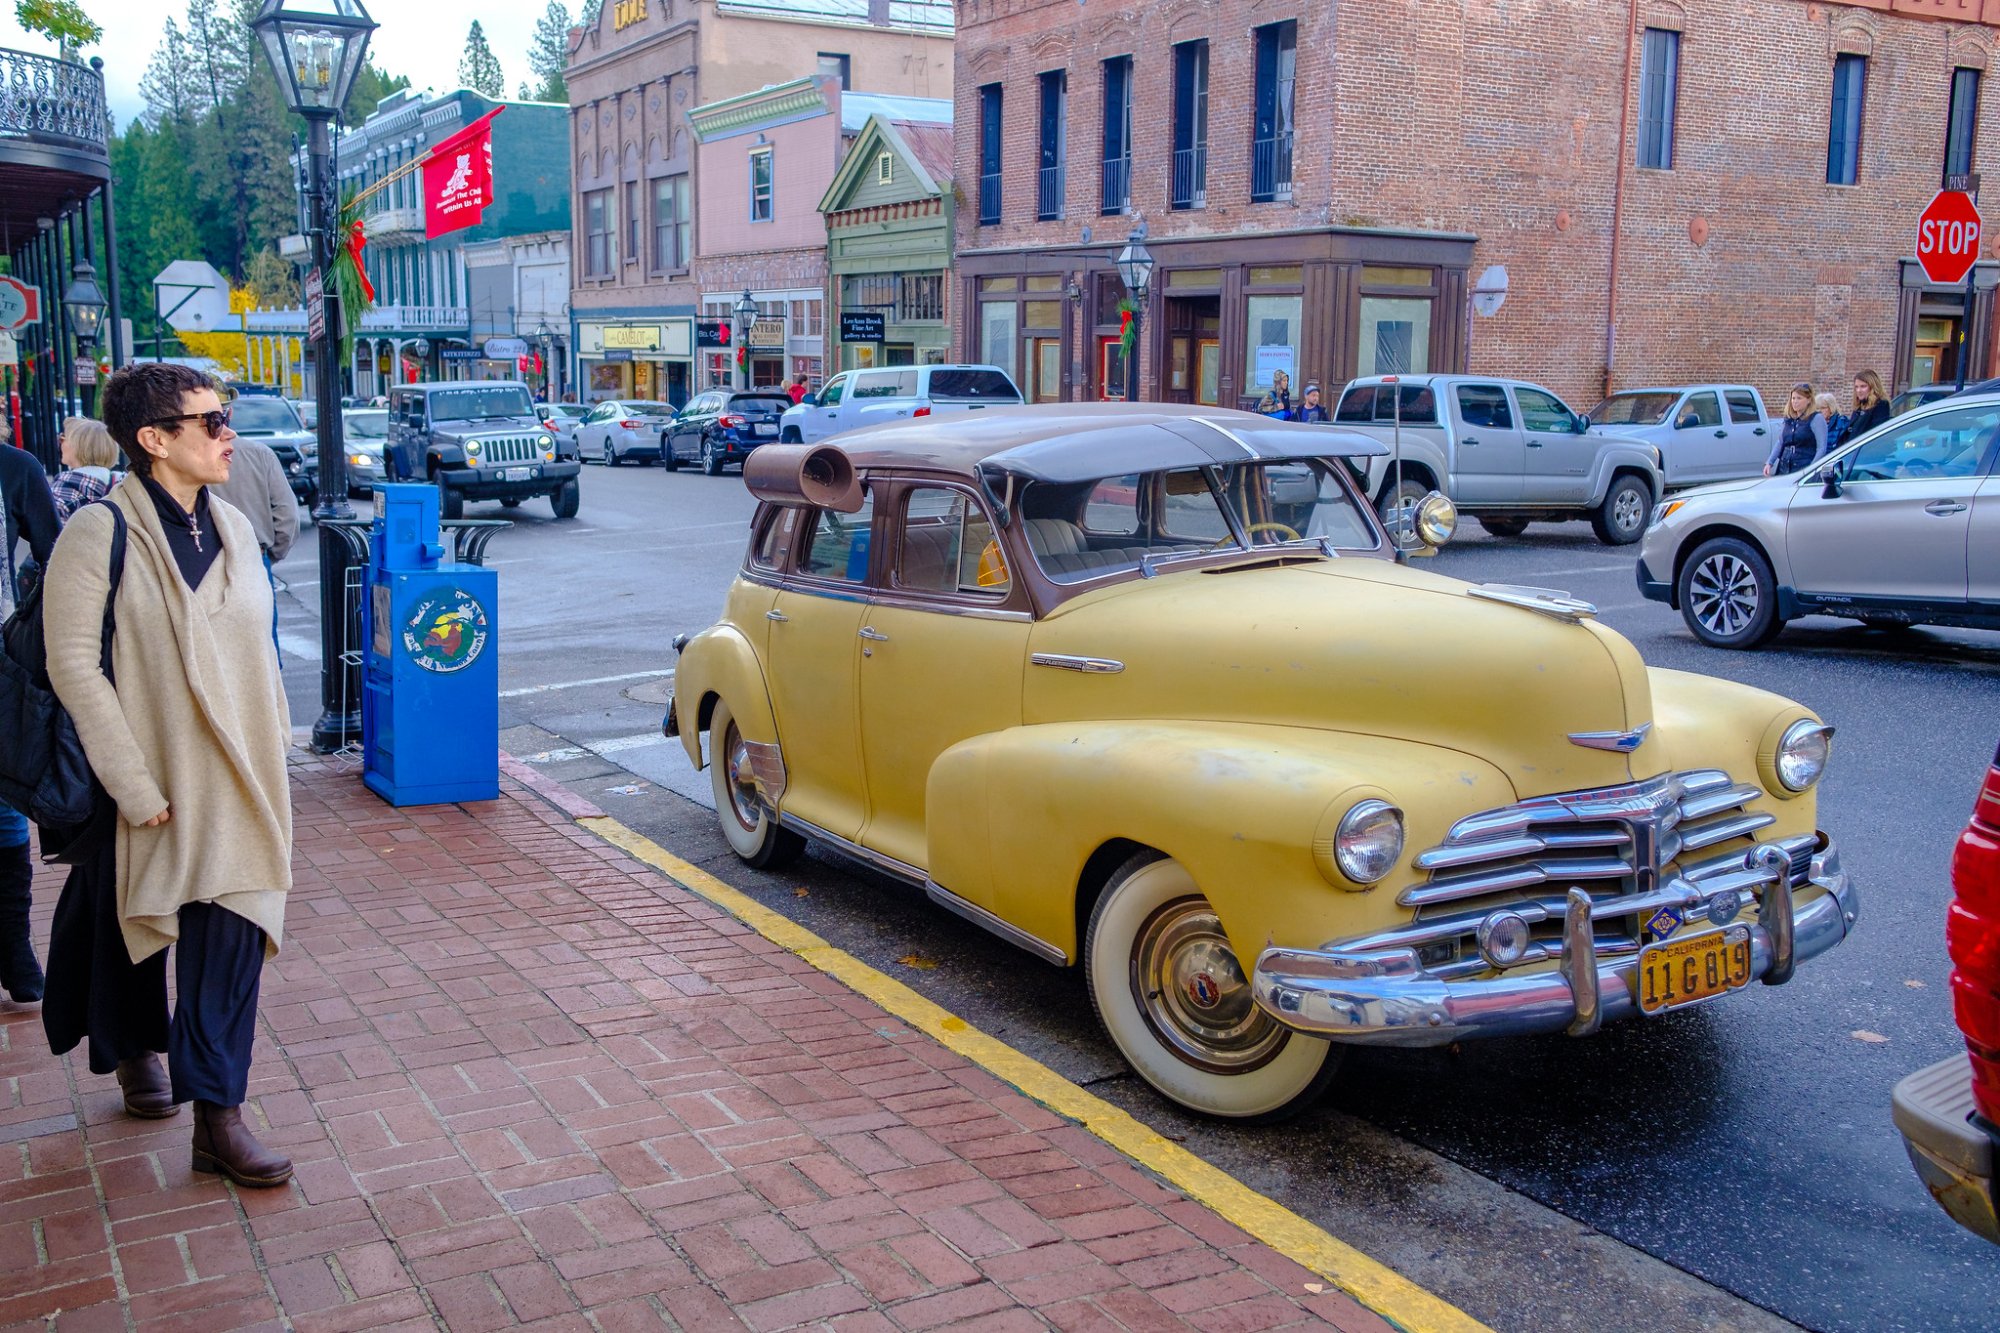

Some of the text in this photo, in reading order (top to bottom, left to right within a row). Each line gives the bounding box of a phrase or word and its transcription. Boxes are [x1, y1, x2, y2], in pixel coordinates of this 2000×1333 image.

[1948, 176, 1968, 190] PINE
[457, 191, 468, 200] The
[1920, 219, 1979, 255] STOP
[617, 331, 645, 345] CAMELOT
[488, 341, 511, 353] Bistro
[1815, 595, 1852, 603] OUTBACK
[1666, 936, 1724, 958] CALIFORNIA
